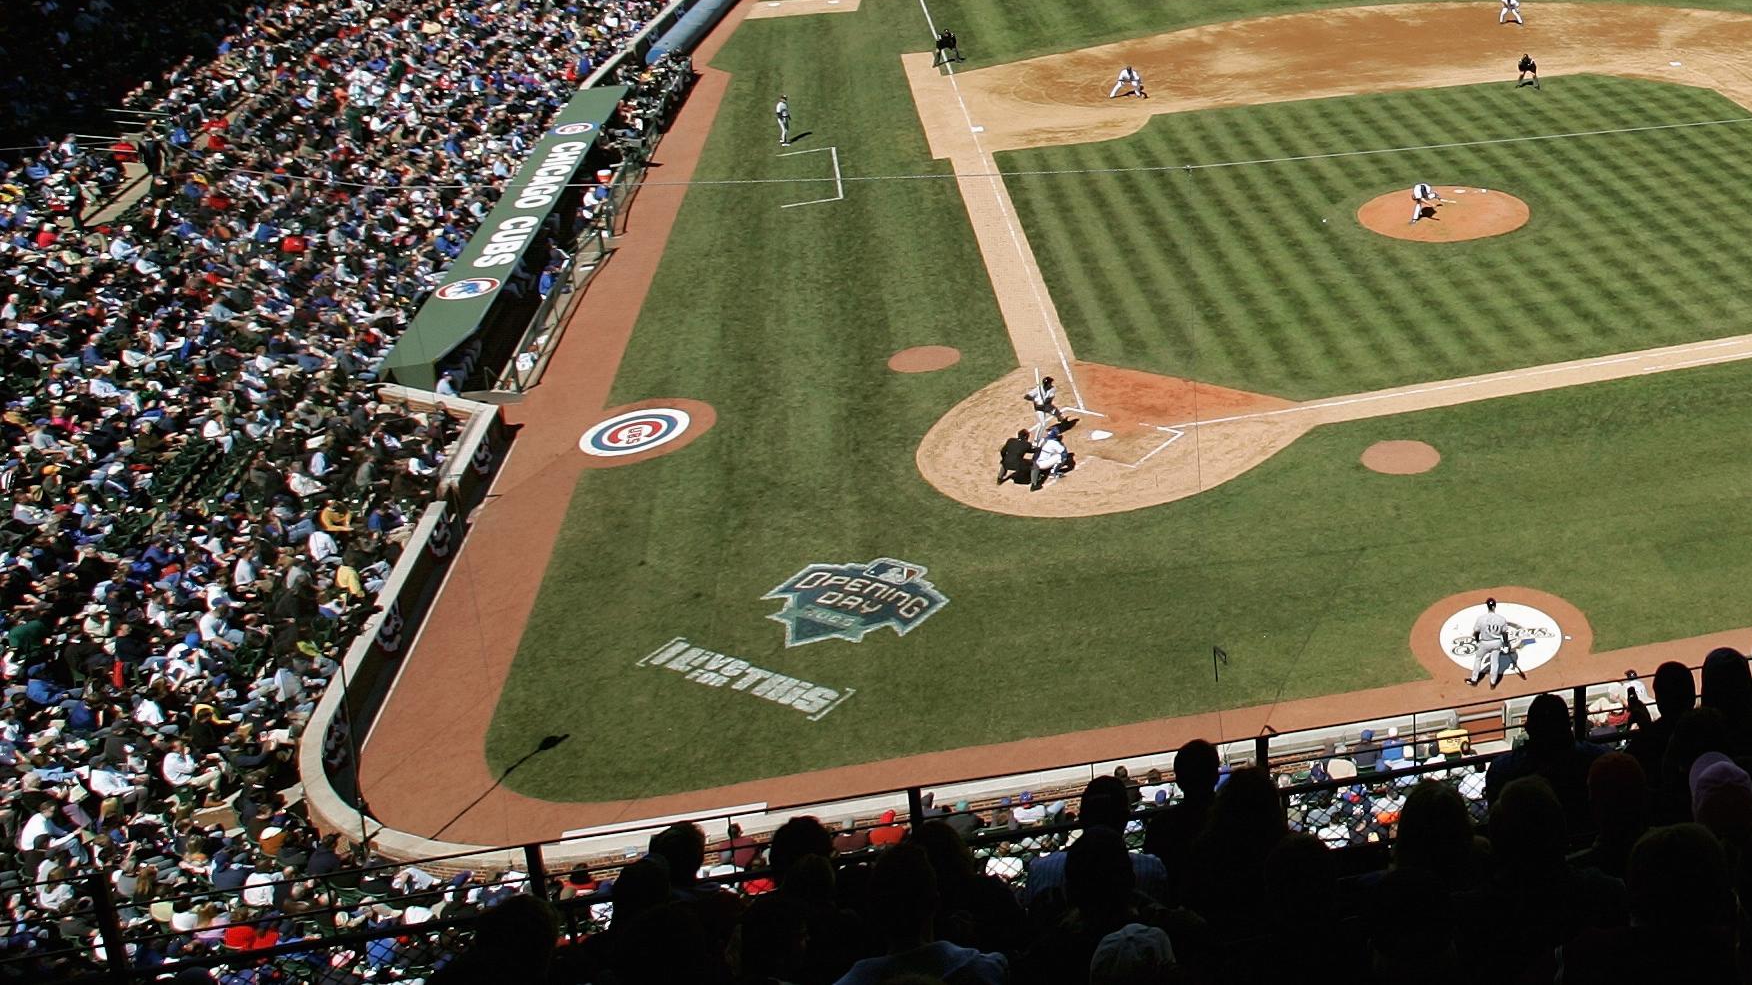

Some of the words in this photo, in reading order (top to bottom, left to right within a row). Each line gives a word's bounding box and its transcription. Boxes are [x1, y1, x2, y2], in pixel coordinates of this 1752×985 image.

[514, 141, 587, 209] CHICAGO
[473, 216, 539, 268] CUBS
[794, 572, 929, 619] OPENING
[815, 591, 883, 614] DAY
